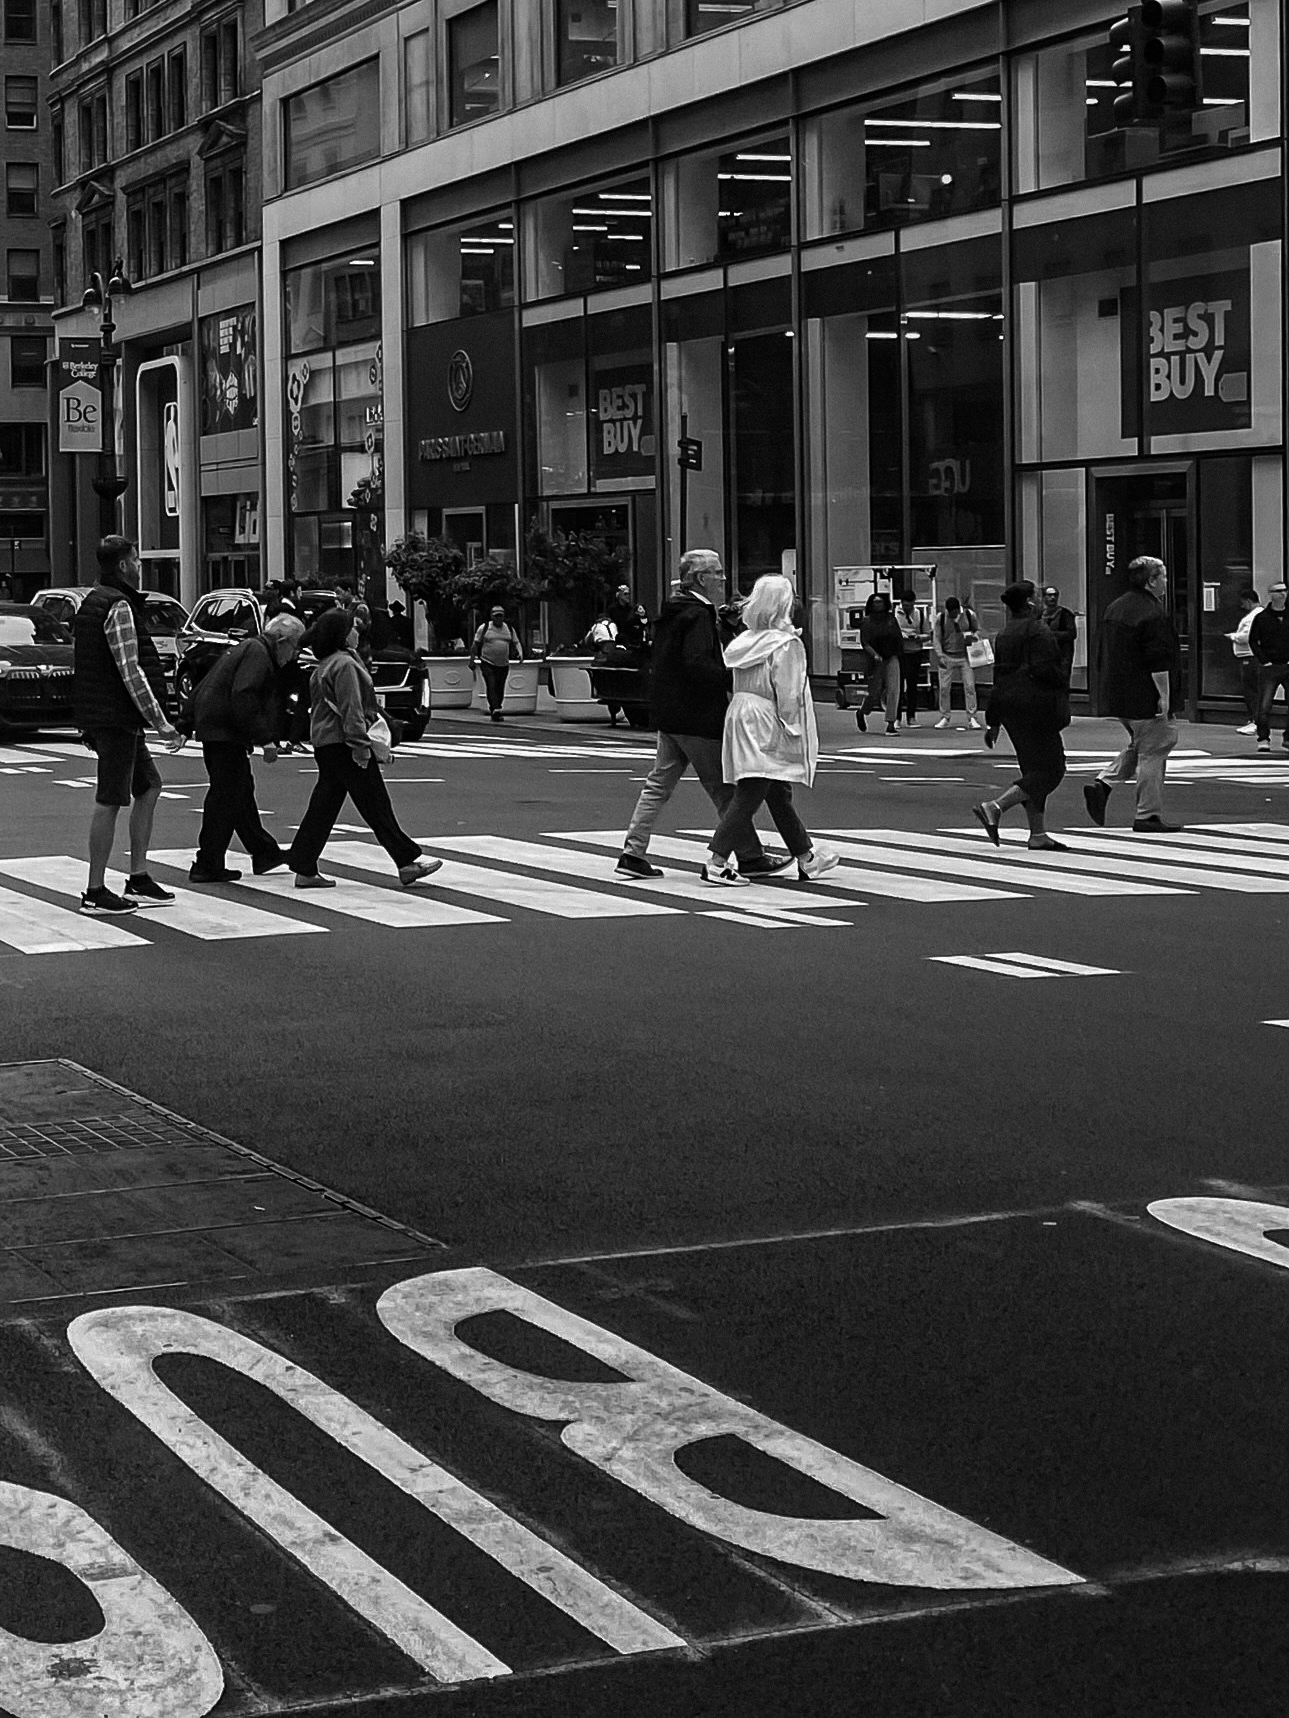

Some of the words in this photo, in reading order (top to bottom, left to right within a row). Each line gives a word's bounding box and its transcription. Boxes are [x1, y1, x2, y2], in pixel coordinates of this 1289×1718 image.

[1150, 300, 1232, 354] BEST
[1150, 349, 1225, 402] BUY
[63, 396, 98, 424] Be
[599, 384, 647, 421] BEST
[602, 418, 643, 455] BUY
[1105, 513, 1115, 542] BEST
[1105, 544, 1115, 568] BUY
